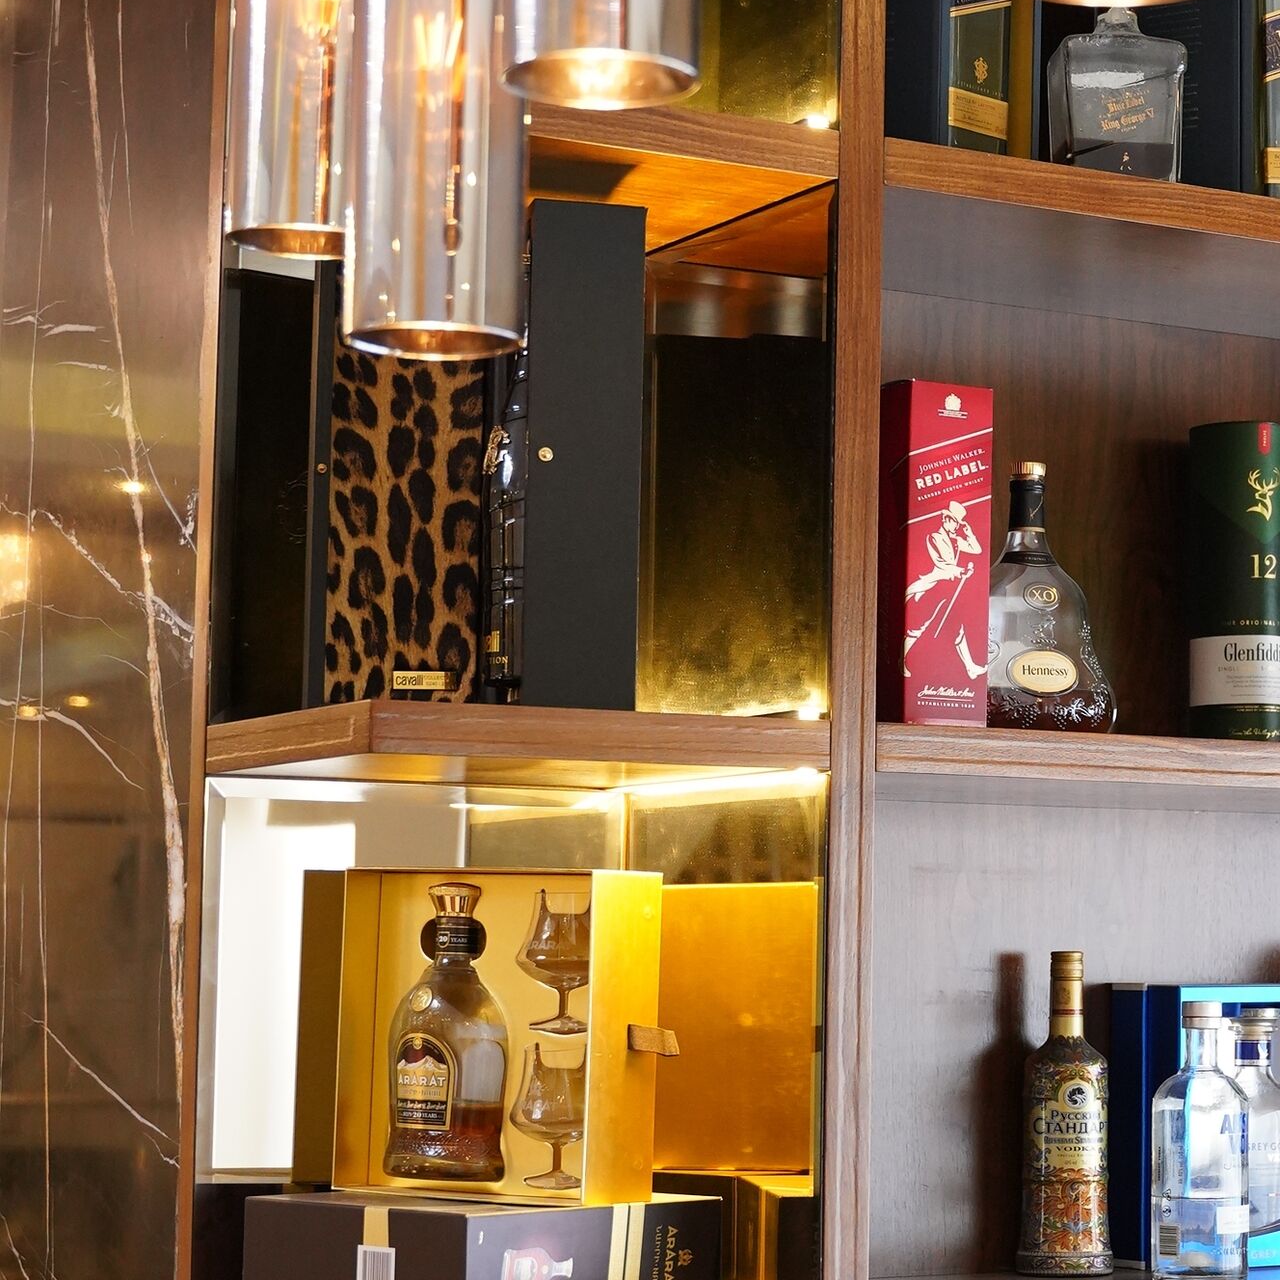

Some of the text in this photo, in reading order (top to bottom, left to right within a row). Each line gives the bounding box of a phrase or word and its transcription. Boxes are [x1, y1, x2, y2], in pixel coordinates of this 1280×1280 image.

[919, 458, 952, 475] JOHNNIE
[915, 473, 942, 490] RED
[1250, 553, 1277, 580] 12
[1022, 664, 1069, 679] Hennessy
[398, 1073, 446, 1087] ARARAT
